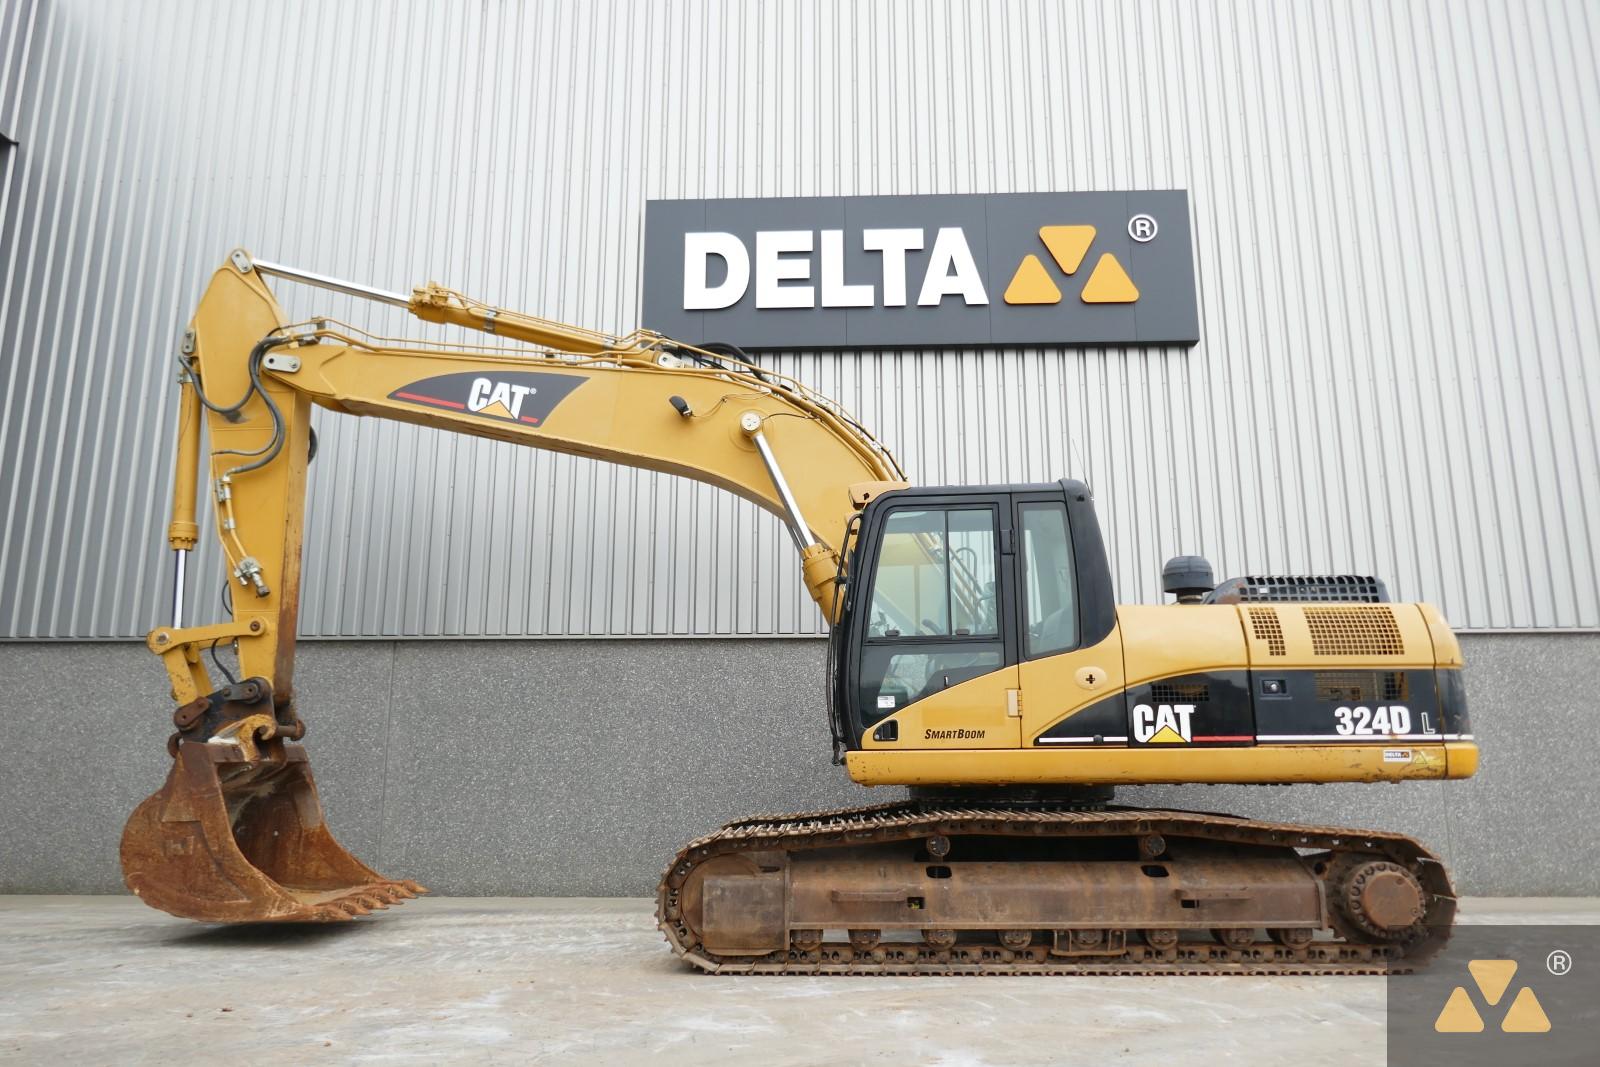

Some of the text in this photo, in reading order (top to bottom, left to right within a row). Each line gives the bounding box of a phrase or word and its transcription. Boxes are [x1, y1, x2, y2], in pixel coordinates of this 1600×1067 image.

[683, 226, 990, 310] DELTA
[1132, 704, 1195, 743] CAT
[1334, 705, 1436, 735] 324D L
